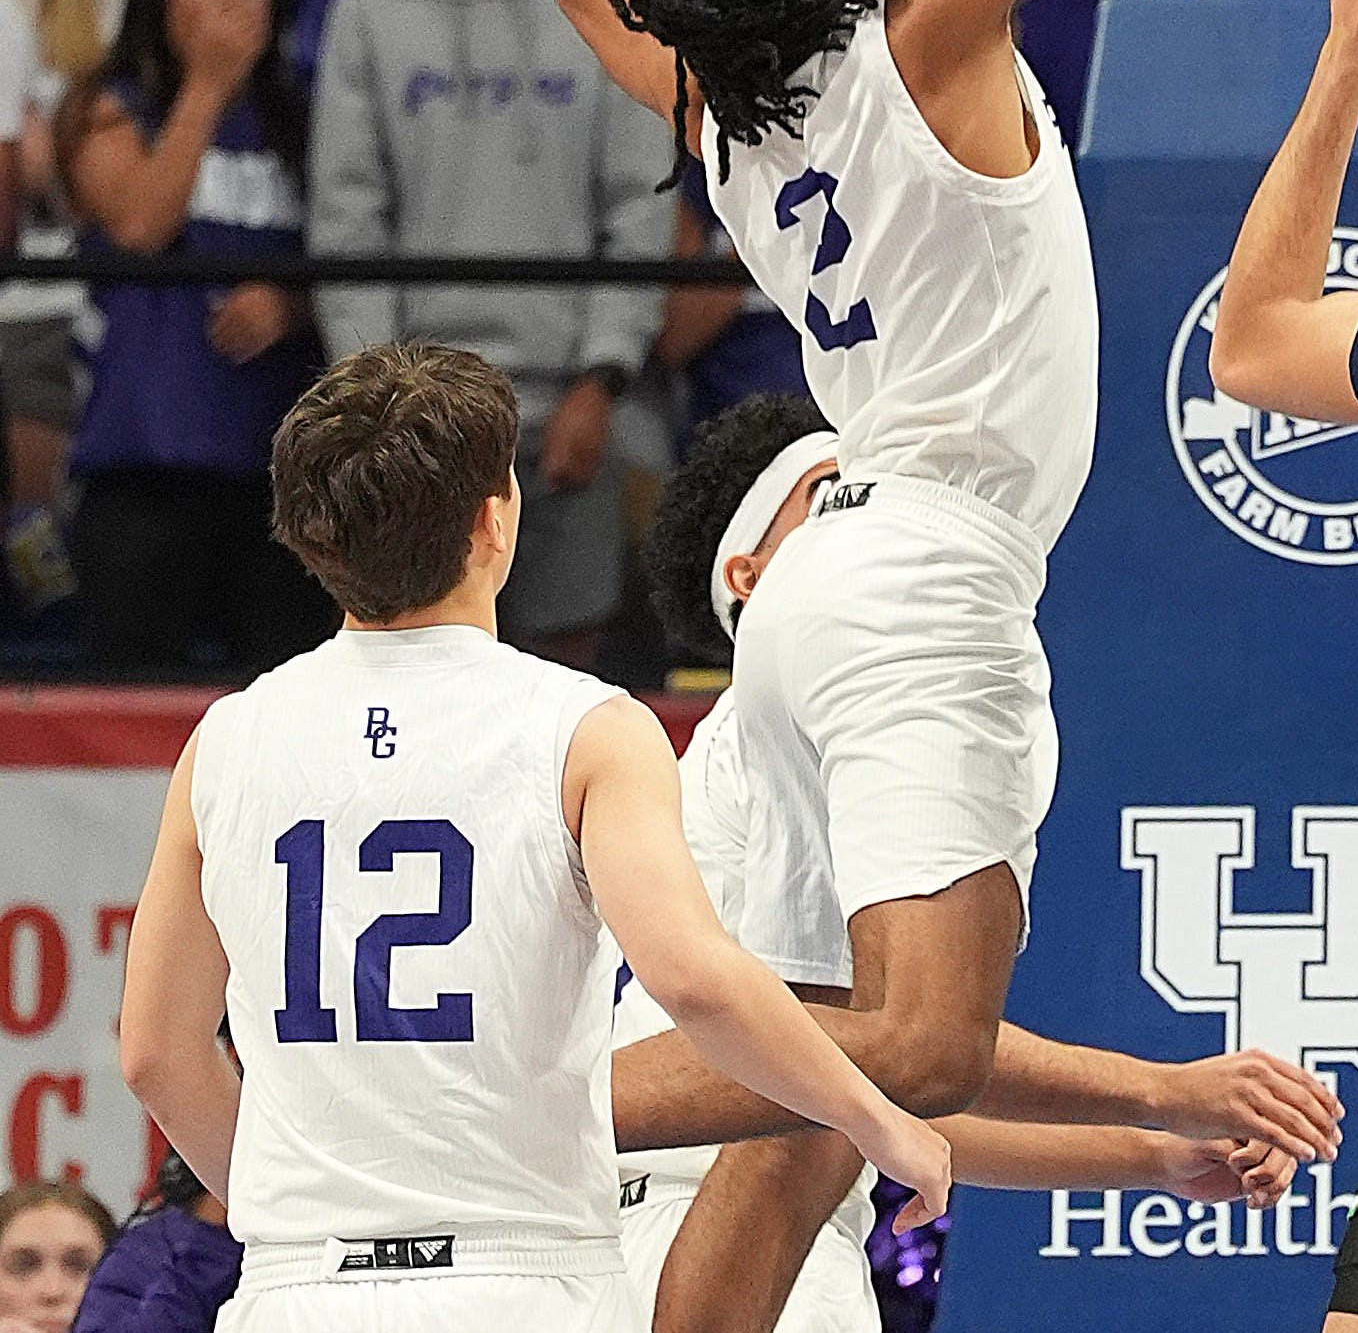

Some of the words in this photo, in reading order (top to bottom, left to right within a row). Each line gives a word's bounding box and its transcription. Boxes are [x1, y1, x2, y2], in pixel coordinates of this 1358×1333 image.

[775, 166, 877, 352] 2
[1199, 449, 1310, 537] FARM
[364, 707, 397, 758] BG
[275, 819, 474, 1043] 12
[1038, 1163, 1357, 1259] Health
